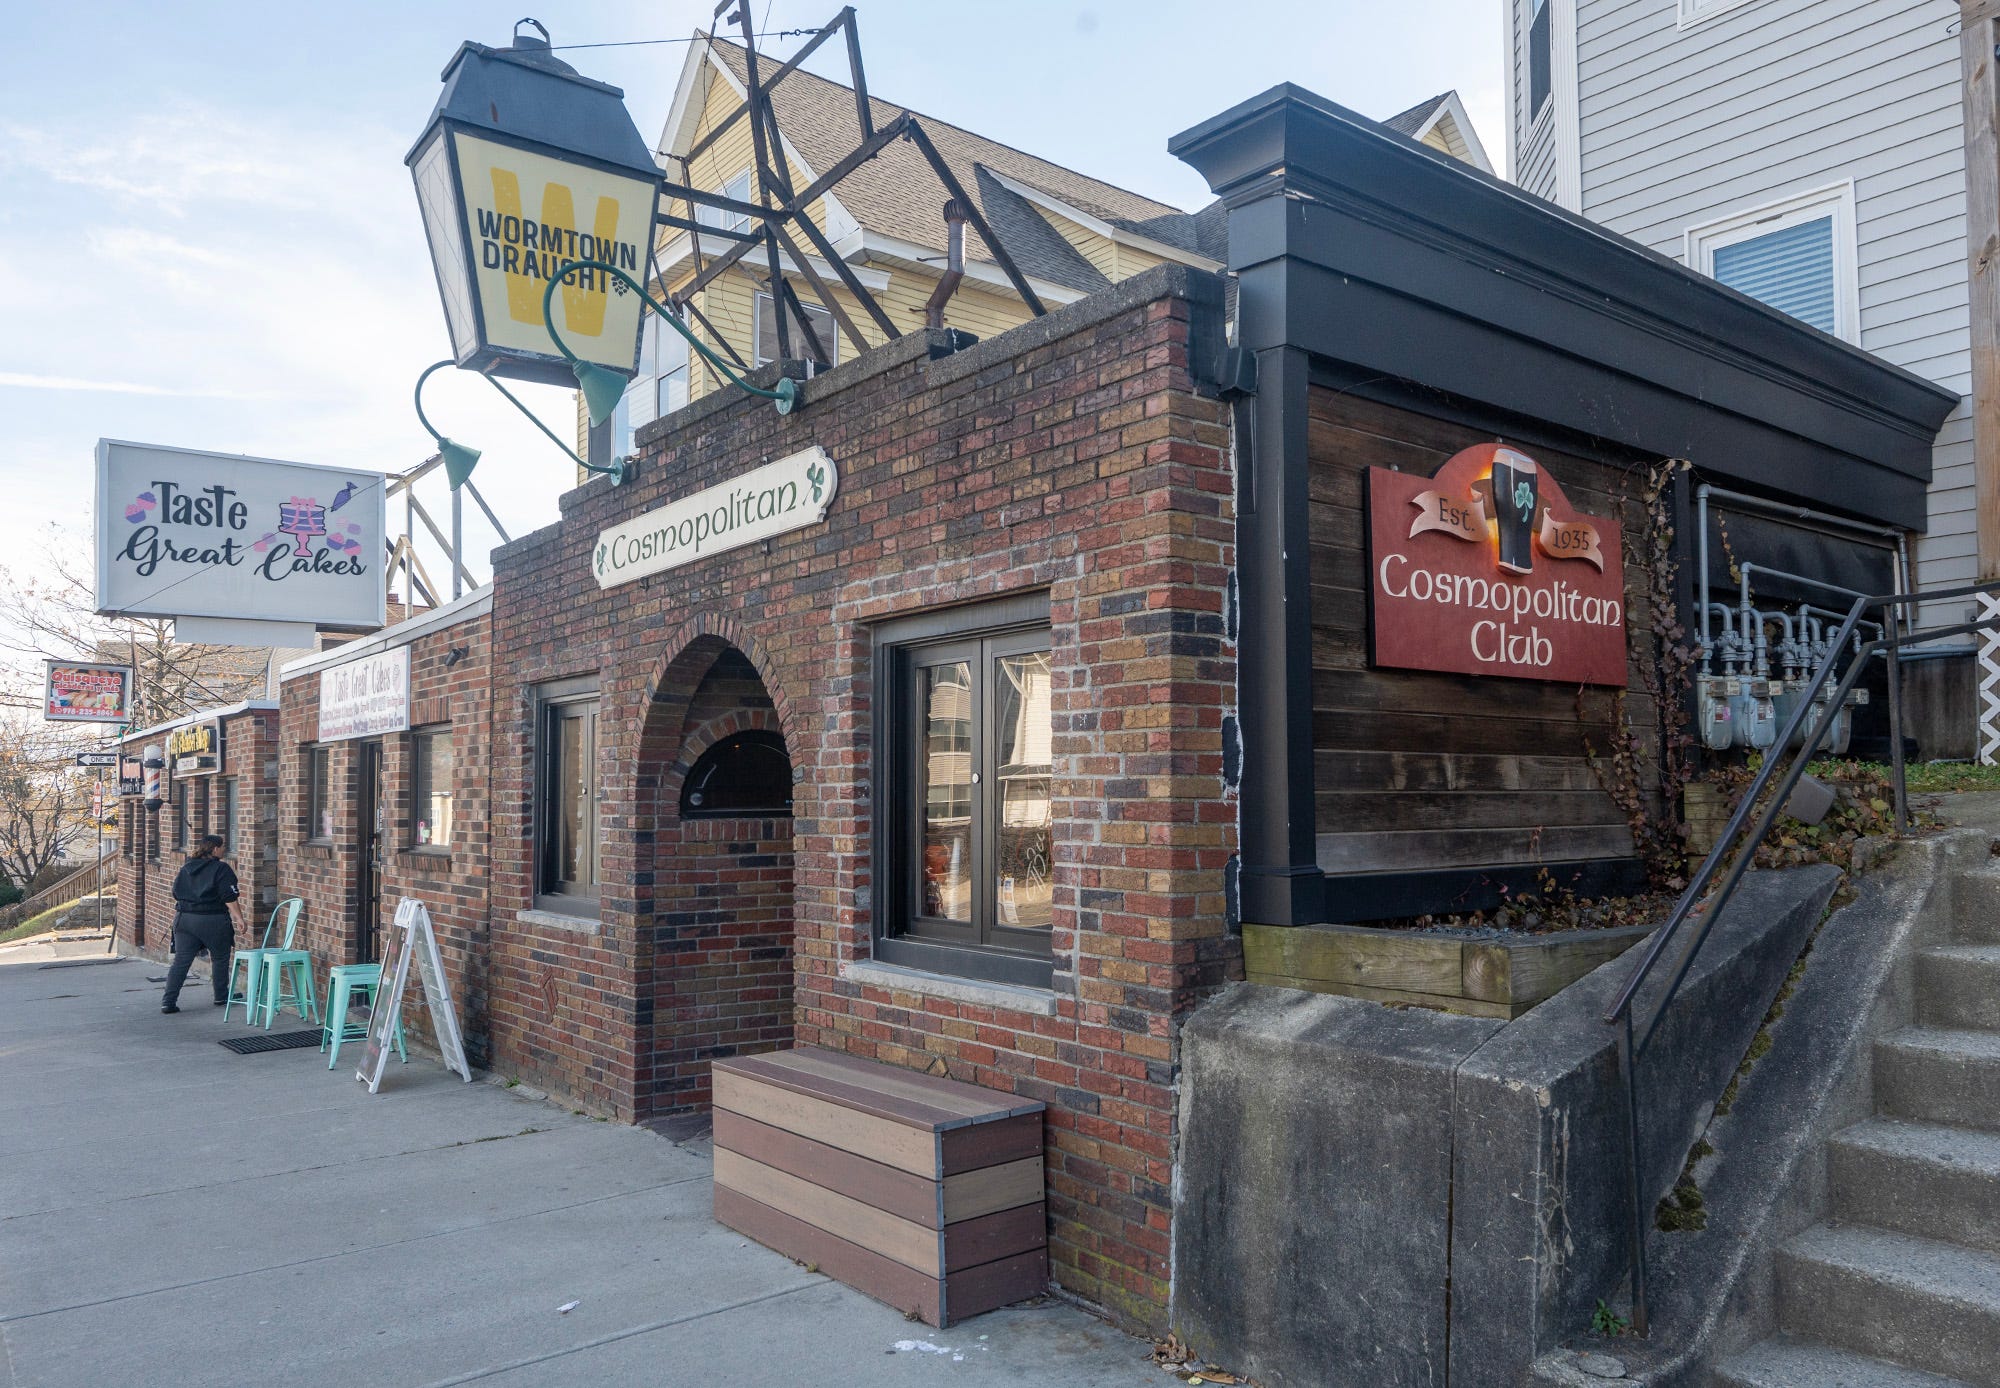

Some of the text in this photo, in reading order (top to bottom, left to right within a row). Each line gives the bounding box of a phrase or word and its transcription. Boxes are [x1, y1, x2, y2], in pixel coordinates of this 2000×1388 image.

[477, 208, 636, 271] WORMTOWN
[483, 240, 606, 293] DRAUGHT
[151, 481, 248, 530] Taste
[611, 480, 797, 570] Cosmopolitan
[1438, 498, 1475, 532] Est.
[116, 525, 367, 581] Great Cakes
[1552, 527, 1590, 550] 1935
[1380, 554, 1621, 626] Cosmopolitan
[1470, 620, 1553, 666] Club
[51, 671, 122, 686] Quisqueya
[351, 664, 369, 699] Great
[372, 661, 390, 694] Cakes
